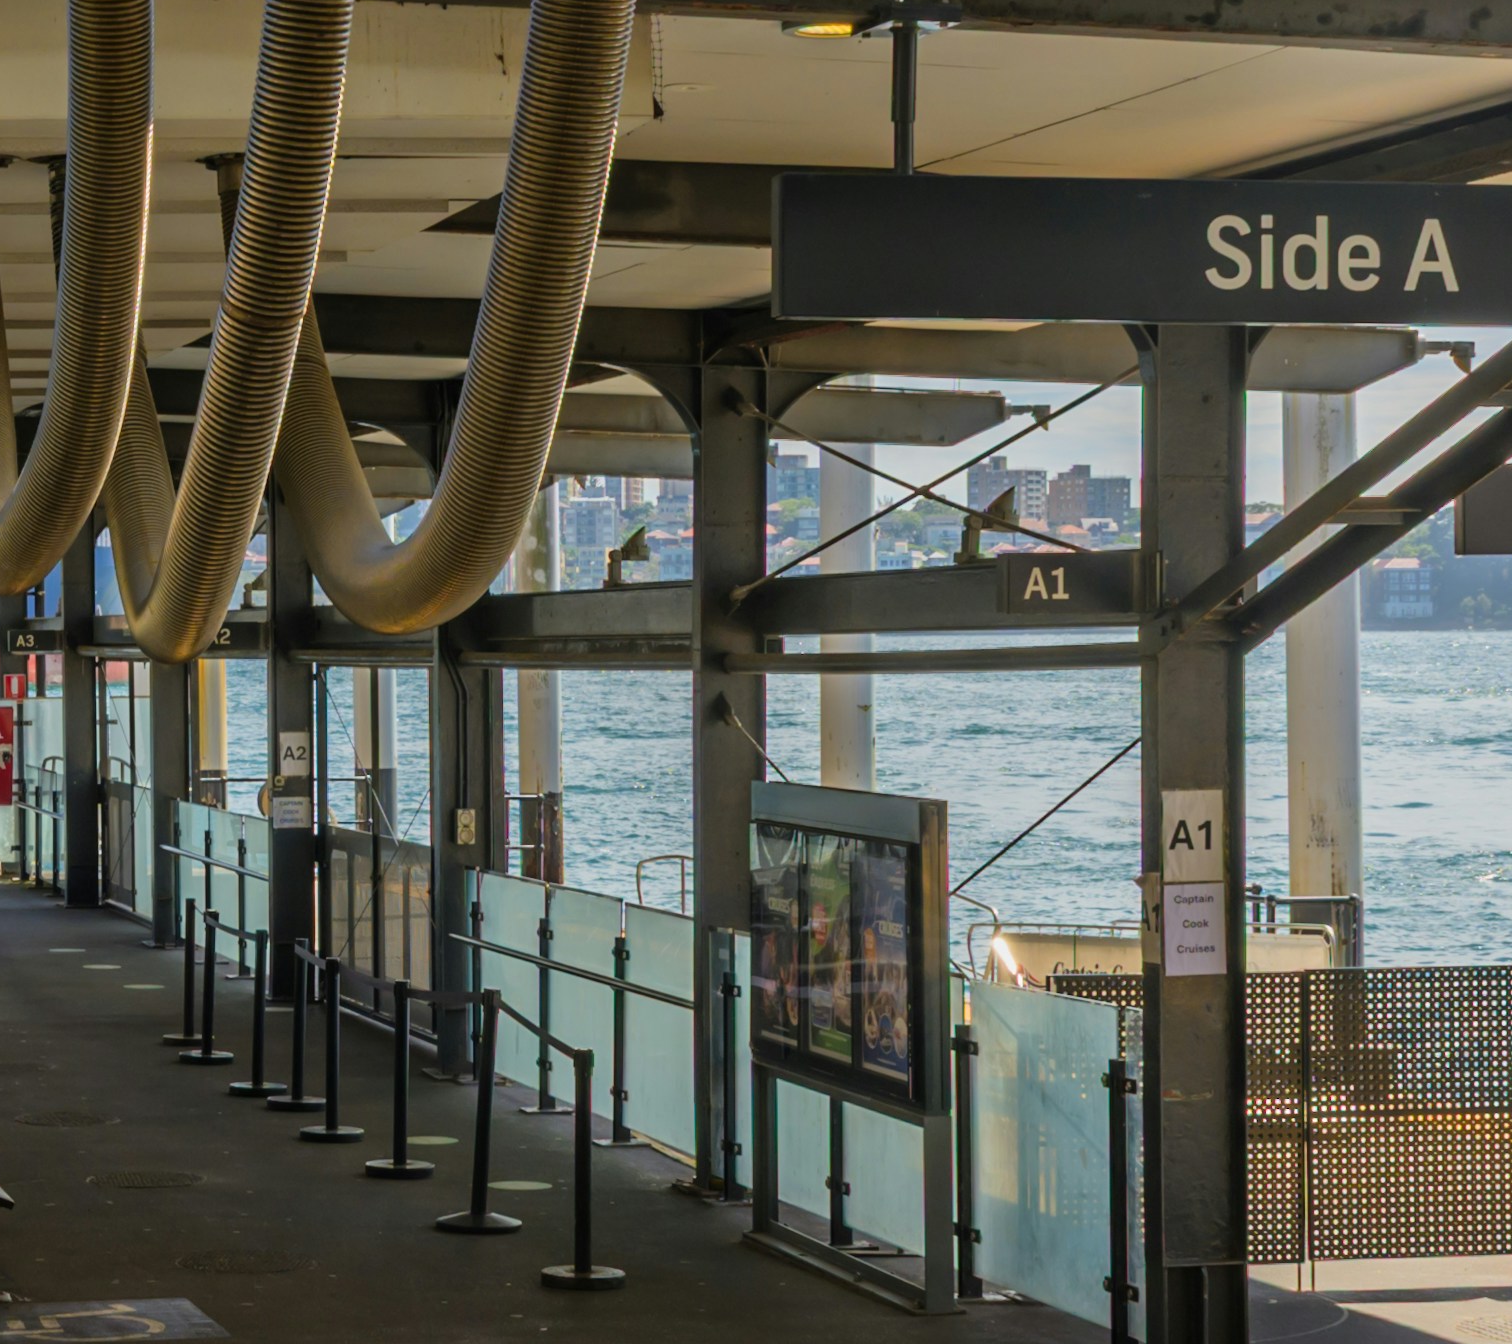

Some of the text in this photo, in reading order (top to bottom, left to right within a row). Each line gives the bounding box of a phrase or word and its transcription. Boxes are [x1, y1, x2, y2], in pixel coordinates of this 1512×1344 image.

[1204, 214, 1461, 294] Side A
[1023, 566, 1070, 601] A1
[16, 635, 35, 647] A3
[214, 628, 231, 644] 2
[283, 746, 307, 761] A2
[1169, 819, 1212, 851] A1
[1173, 895, 1215, 905] Captain
[878, 921, 904, 939] CRUISES
[1182, 919, 1209, 929] Cook
[1176, 944, 1216, 954] Cruises
